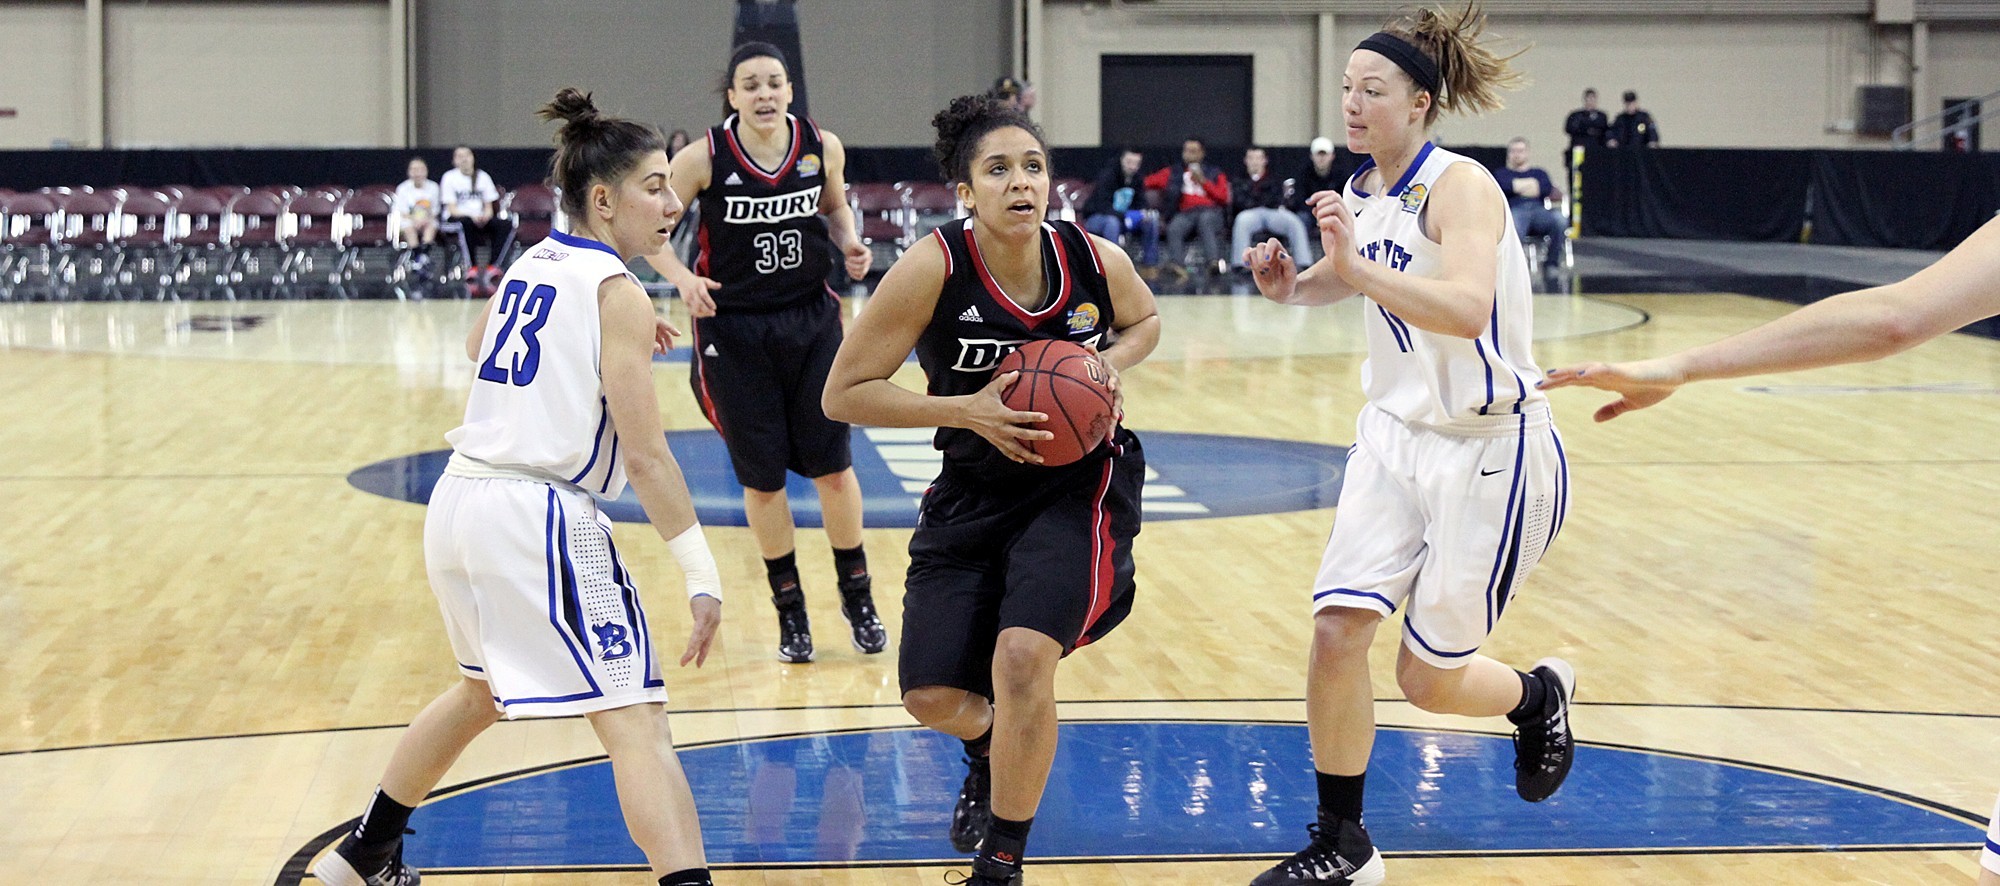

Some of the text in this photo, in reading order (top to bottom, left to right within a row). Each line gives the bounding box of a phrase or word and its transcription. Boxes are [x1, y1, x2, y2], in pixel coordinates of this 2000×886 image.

[724, 186, 822, 223] DRURY
[754, 229, 802, 274] 33
[478, 279, 557, 387] 23
[958, 314, 983, 323] adidas
